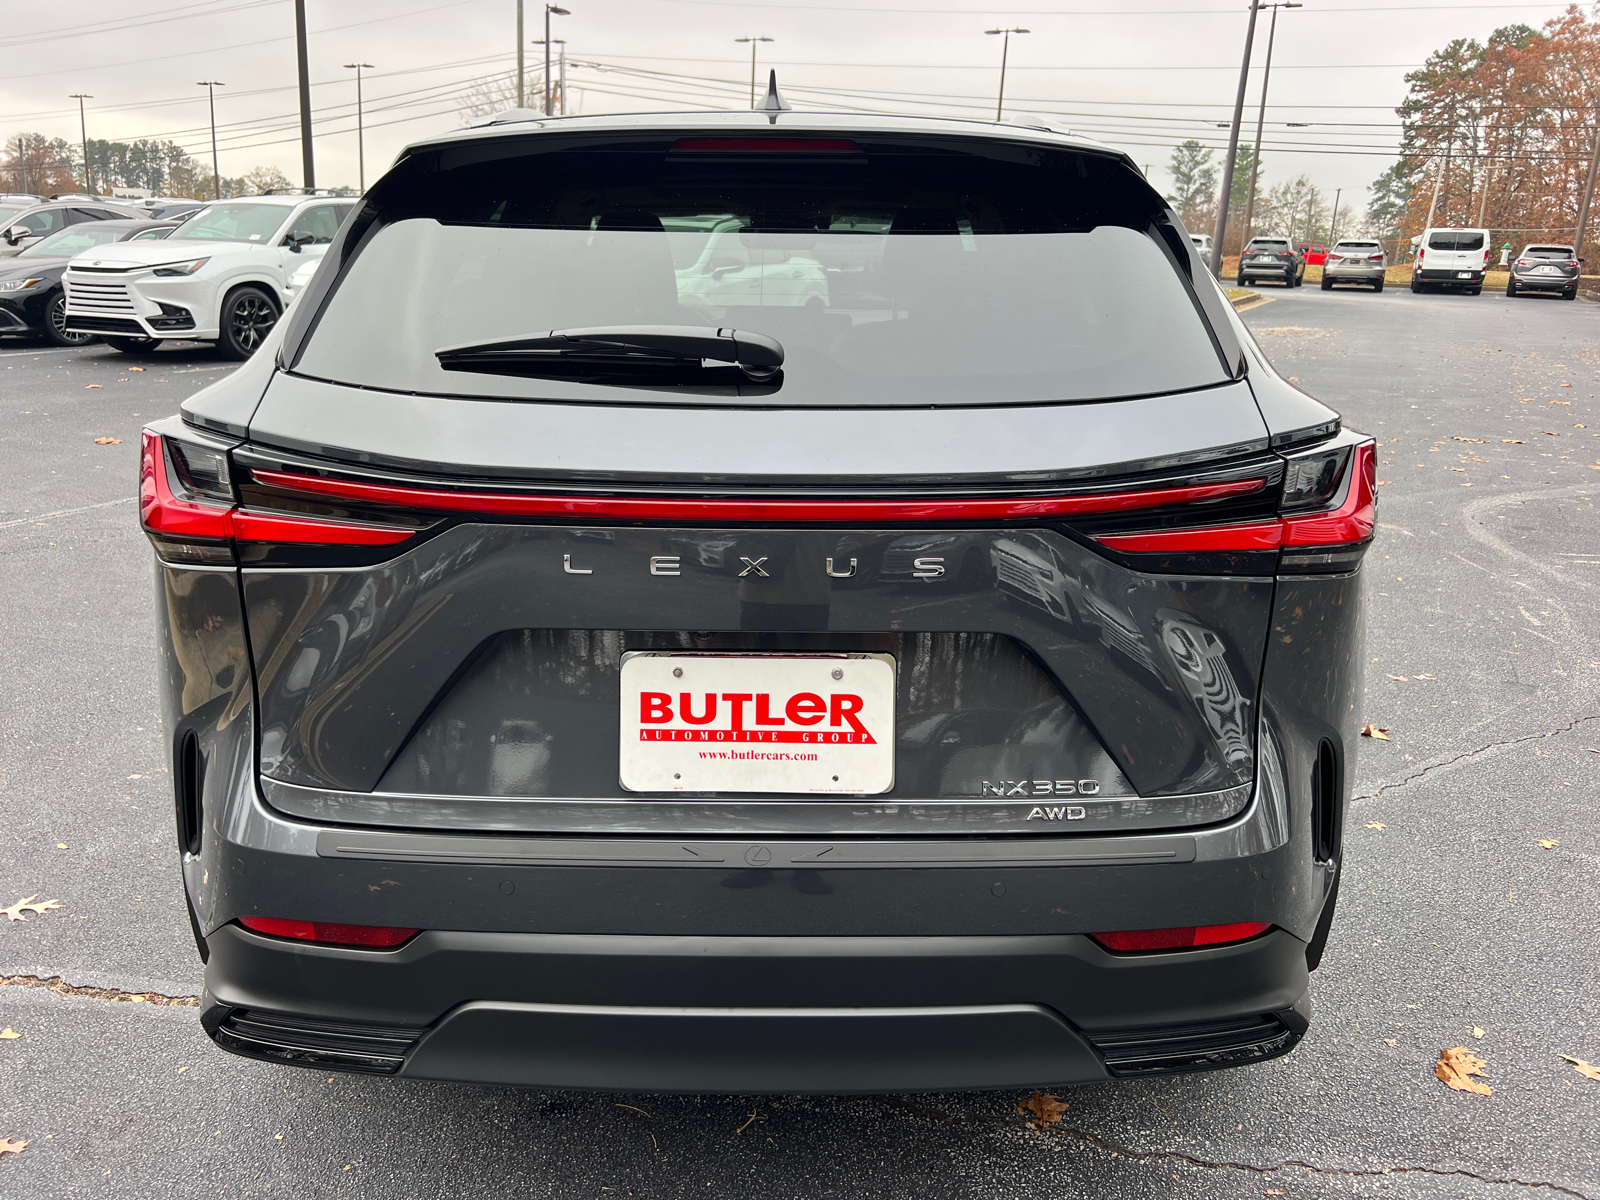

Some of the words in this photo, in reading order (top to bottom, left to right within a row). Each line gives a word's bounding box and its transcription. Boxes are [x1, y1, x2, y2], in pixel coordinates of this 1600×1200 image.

[563, 554, 946, 579] LEXUS
[640, 730, 778, 742] AUTOMOTIVE
[802, 732, 869, 743] GROUP
[698, 749, 818, 762] www.butlercars.com
[1026, 806, 1086, 821] AWD
